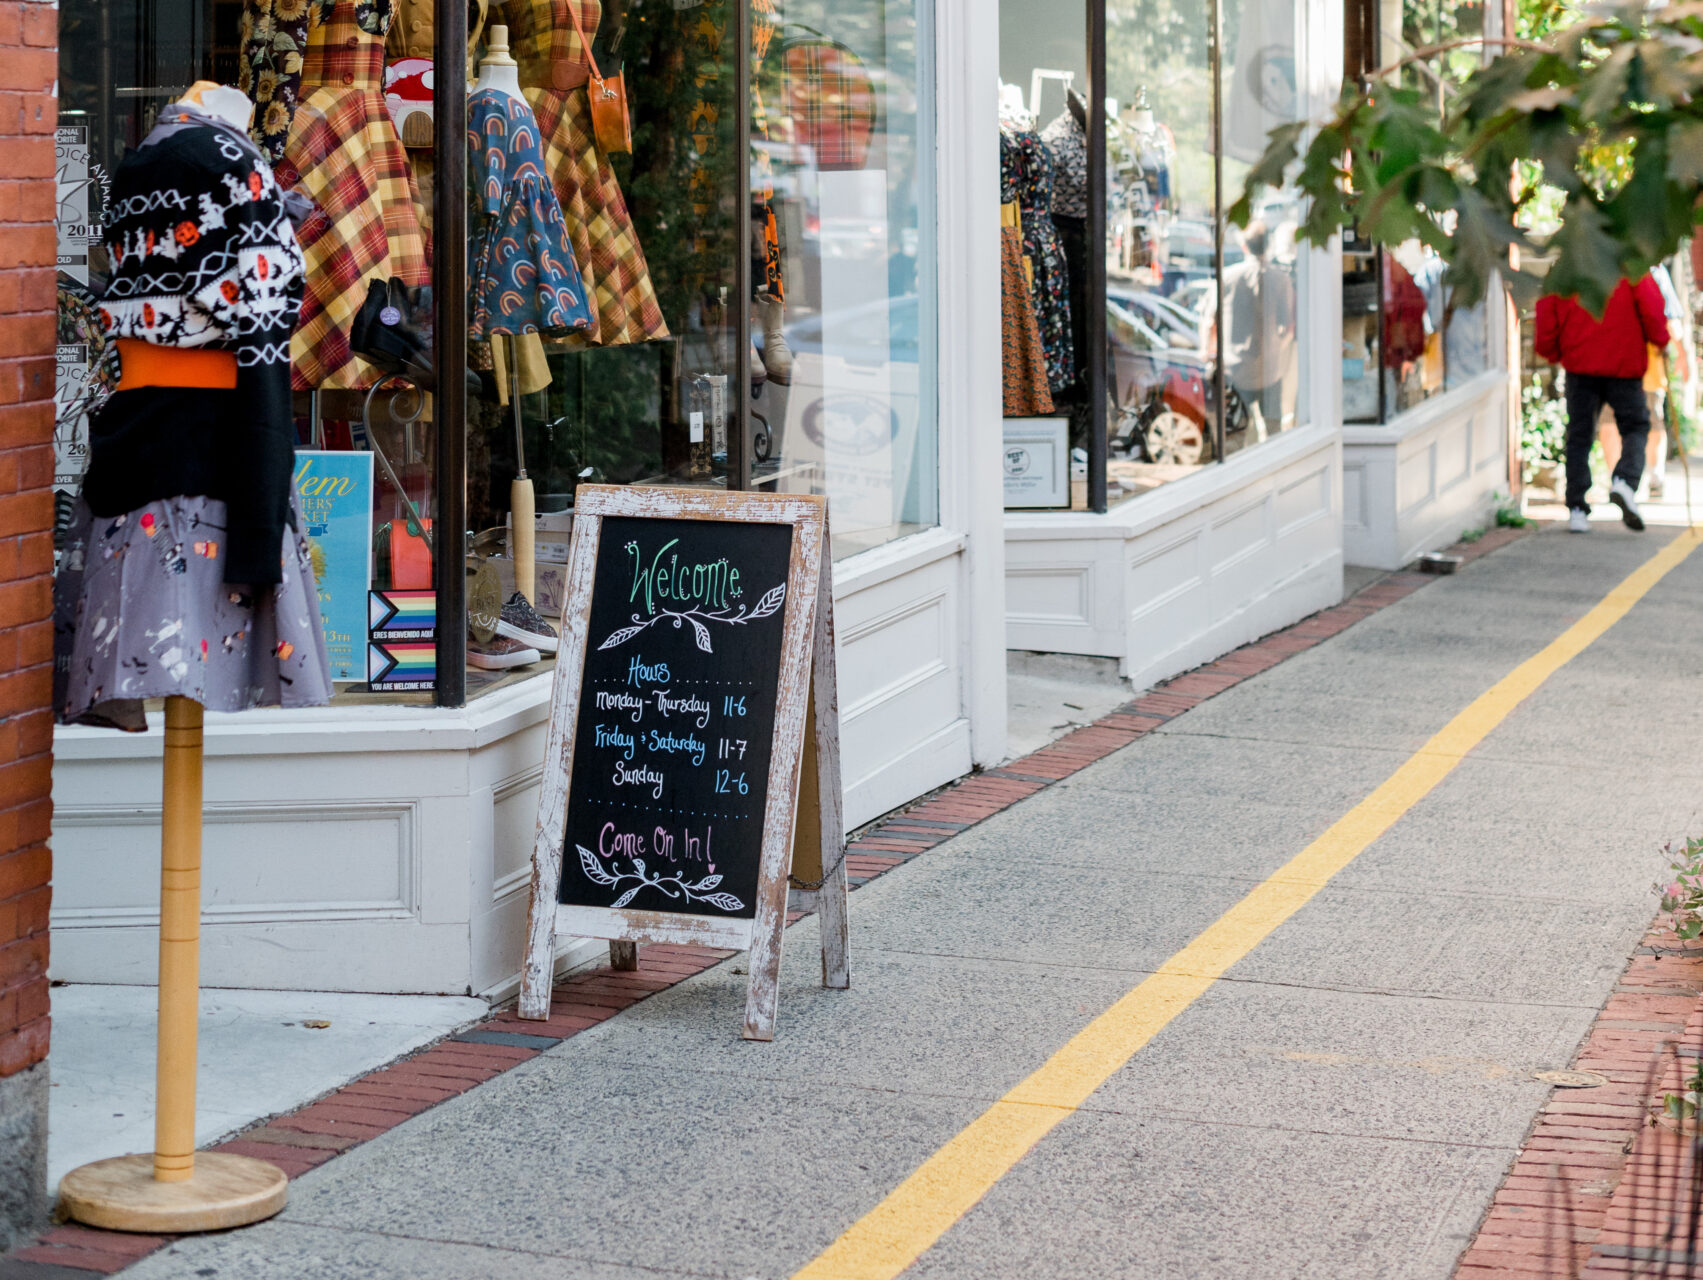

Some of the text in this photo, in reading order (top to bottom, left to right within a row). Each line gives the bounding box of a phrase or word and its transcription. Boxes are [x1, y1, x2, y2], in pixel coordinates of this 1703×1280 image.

[57, 128, 79, 136] ONAL
[56, 147, 91, 165] OICE
[67, 224, 103, 236] 2011
[57, 354, 78, 362] ORITE
[56, 365, 90, 382] OICE
[56, 475, 73, 483] LVER
[296, 459, 358, 496] lem
[302, 510, 330, 522] KET
[627, 538, 741, 615] Welcome
[627, 654, 670, 688] Hours
[371, 683, 382, 691] YOU
[383, 682, 393, 690] ARE
[394, 682, 419, 690] WELCOME
[723, 696, 747, 717] 11-6
[595, 723, 635, 760] Friday
[649, 729, 706, 766] Saturday
[719, 738, 748, 760] 11-7
[612, 761, 749, 799] Sunday 12-6
[599, 821, 646, 860] Come
[653, 826, 677, 863] On
